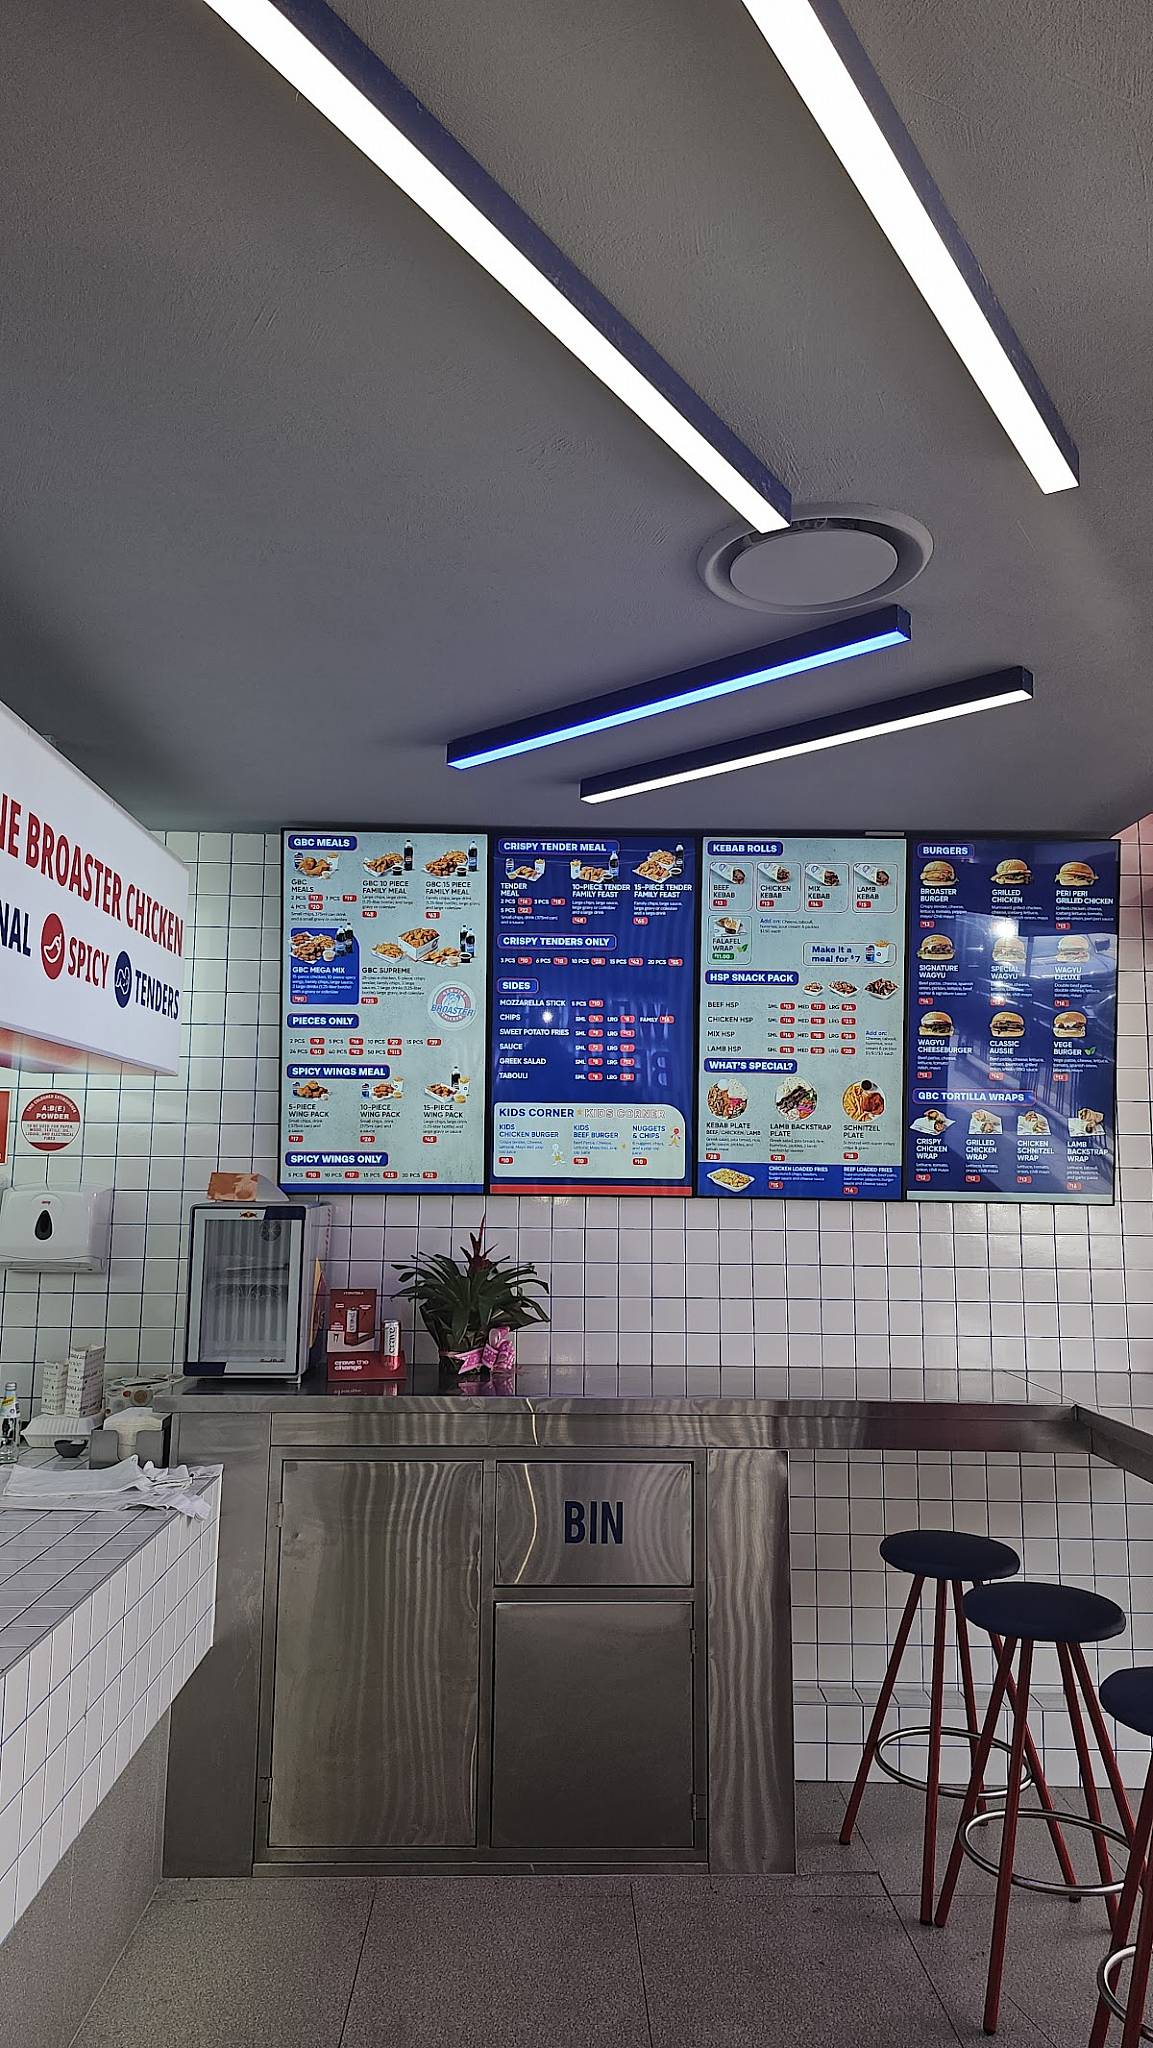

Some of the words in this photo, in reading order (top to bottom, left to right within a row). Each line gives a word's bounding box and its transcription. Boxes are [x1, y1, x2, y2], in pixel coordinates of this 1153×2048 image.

[316, 838, 350, 847] MEALS
[26, 812, 122, 921] BROASTER
[127, 884, 183, 956] CHICKEN
[68, 937, 109, 988] SPICY
[135, 970, 179, 1019] TENDERS
[432, 1005, 474, 1016] BROASTER
[750, 1062, 793, 1070] SPECIAL?
[941, 1092, 986, 1100] TORTILLA
[585, 1109, 613, 1118] KIDS
[617, 1110, 665, 1118] CORNER
[565, 1501, 623, 1544] BIN
